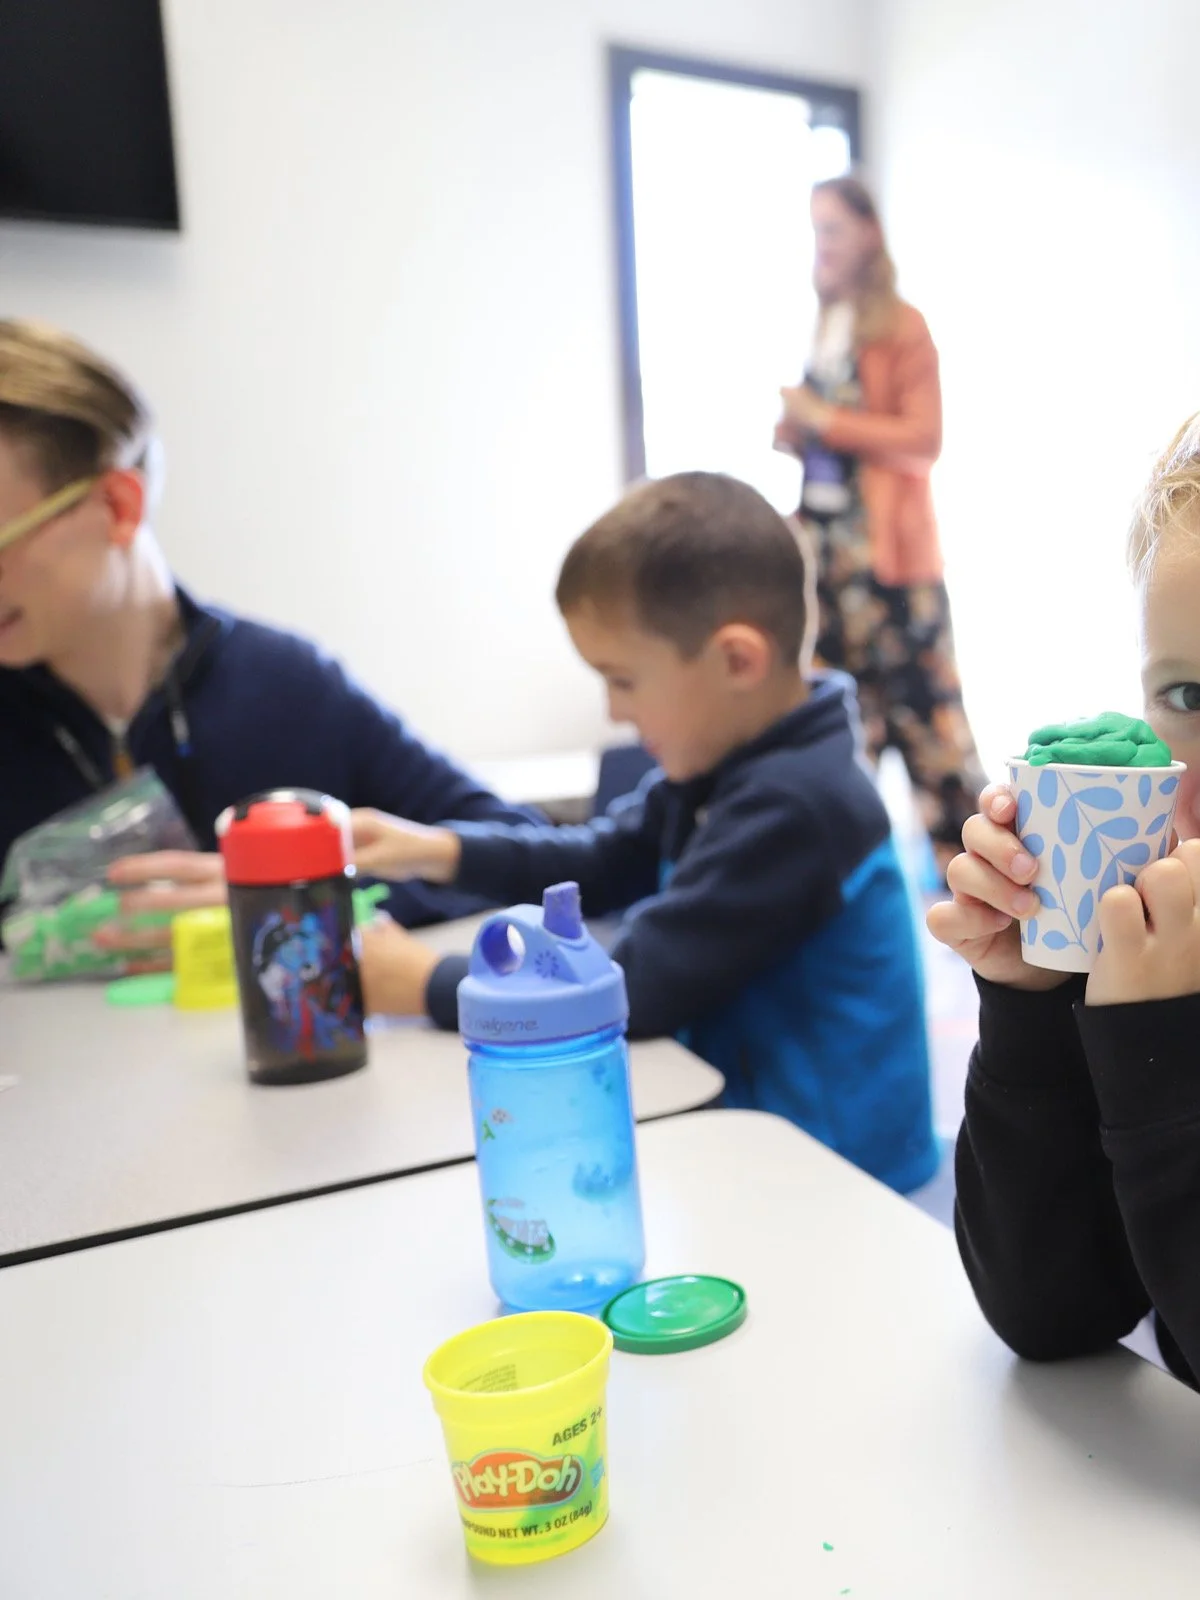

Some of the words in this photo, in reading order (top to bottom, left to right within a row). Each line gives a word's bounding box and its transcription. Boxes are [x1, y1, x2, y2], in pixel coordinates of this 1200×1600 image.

[552, 1418, 588, 1446] AGES
[453, 1455, 577, 1501] Play-Doh
[498, 1527, 518, 1538] NET
[521, 1525, 543, 1537] WT.
[545, 1521, 551, 1532] 3
[554, 1515, 568, 1529] OZ
